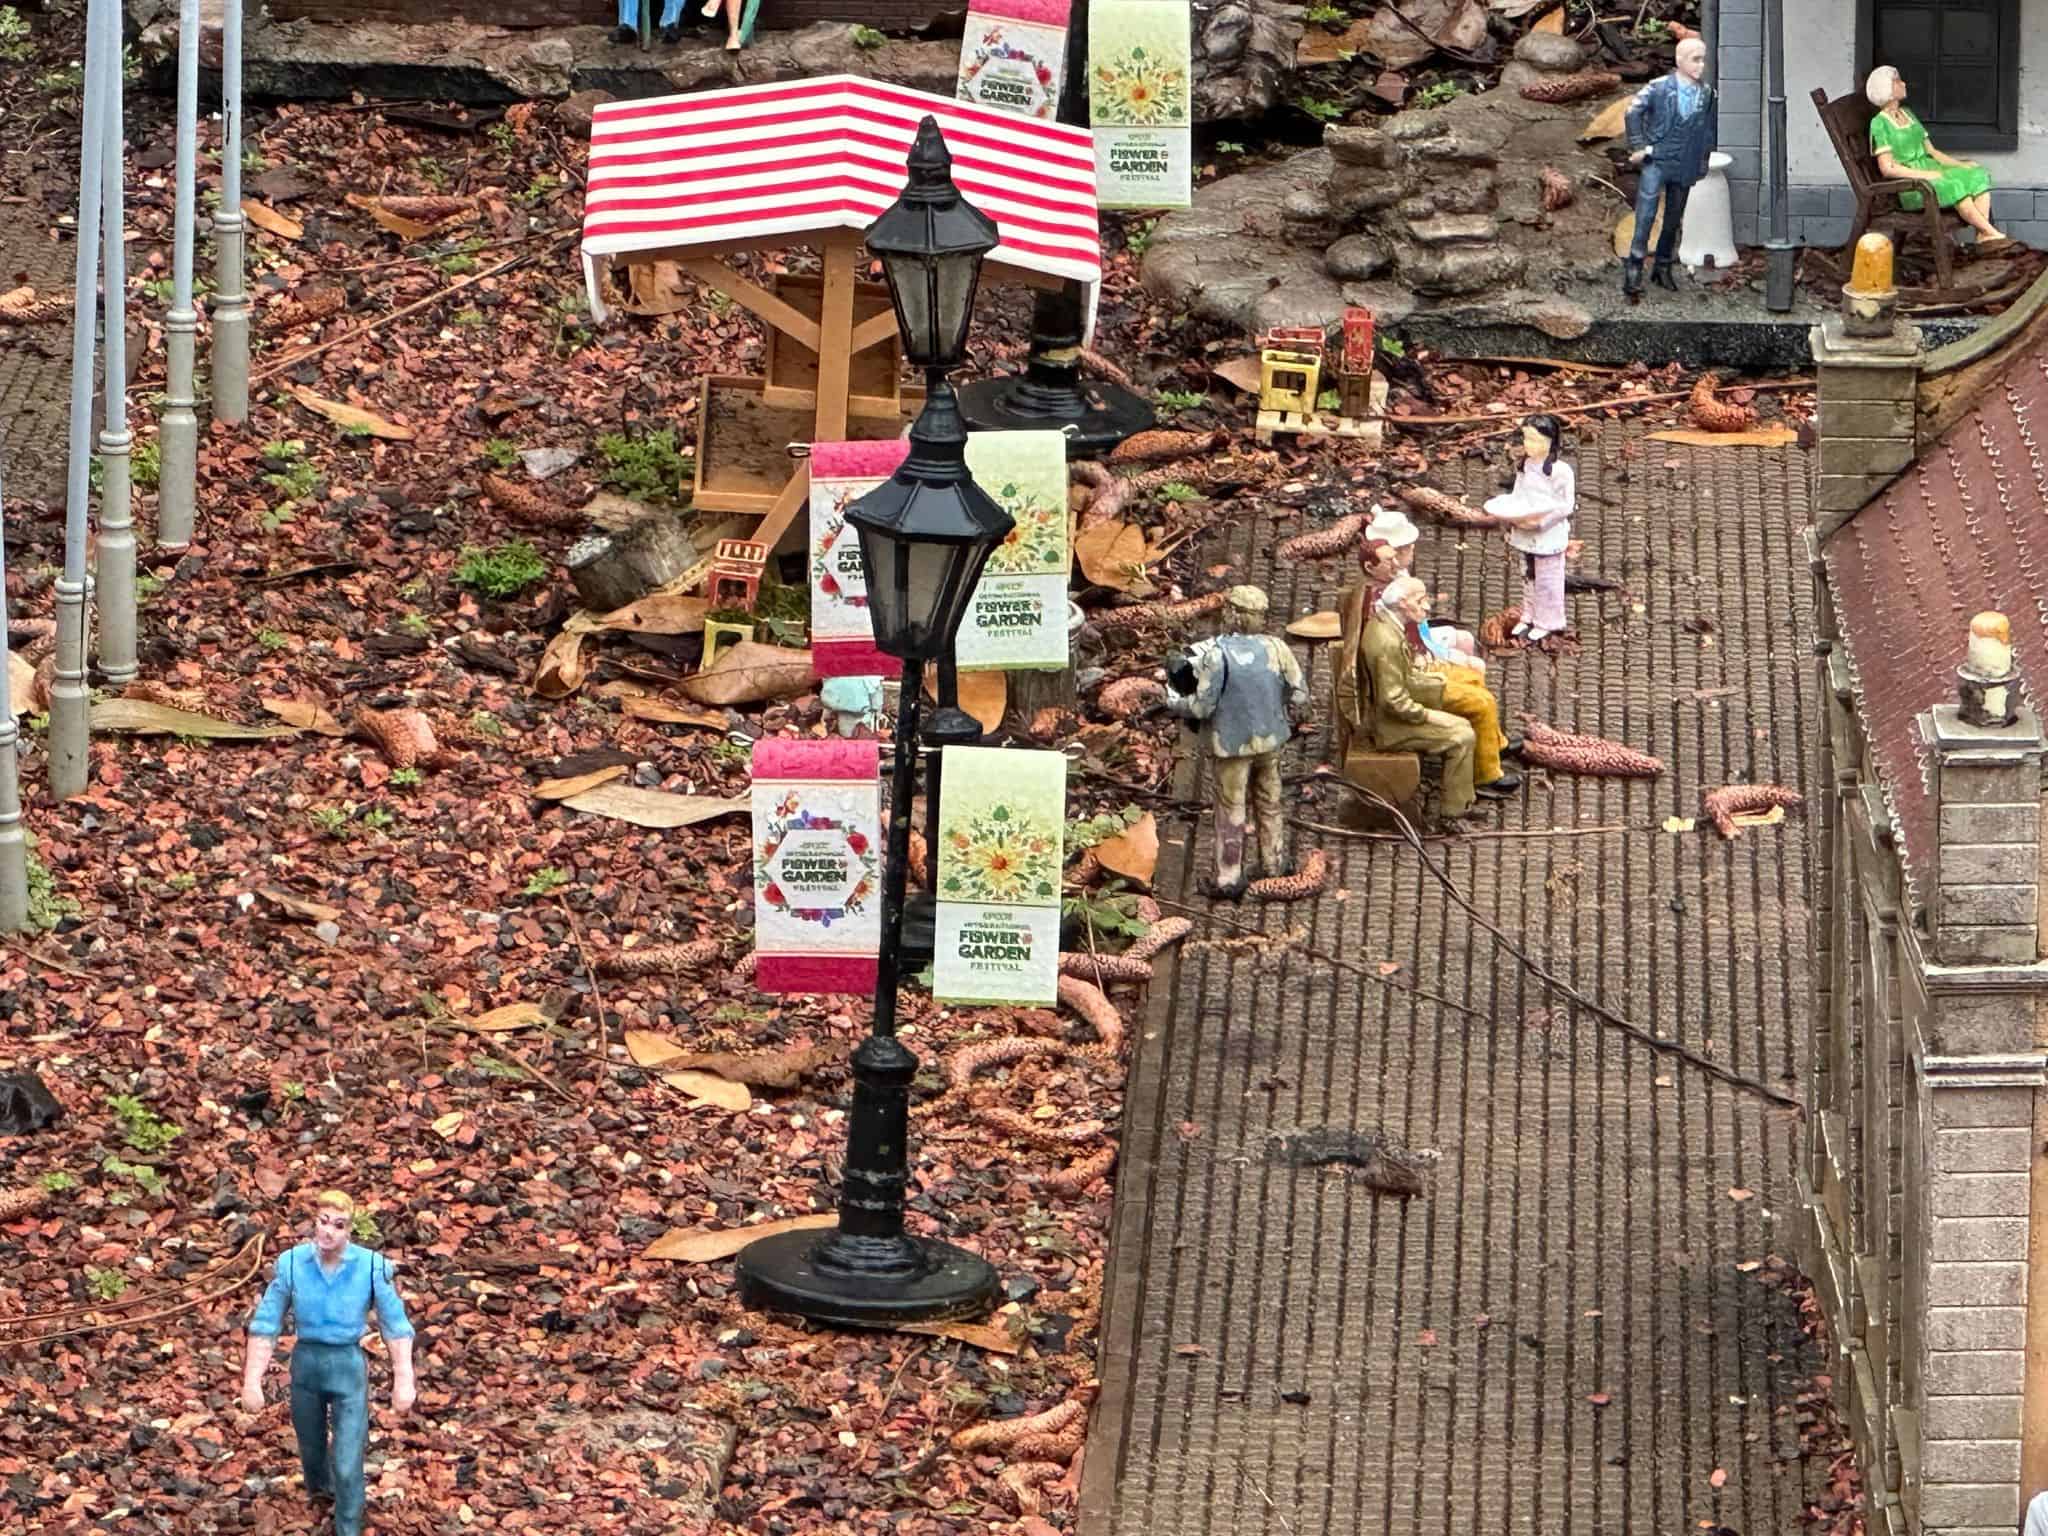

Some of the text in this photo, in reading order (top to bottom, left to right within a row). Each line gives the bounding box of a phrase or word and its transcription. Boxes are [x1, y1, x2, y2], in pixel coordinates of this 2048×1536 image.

[980, 89, 1032, 105] GARDEN
[1110, 149, 1158, 160] FLOWER
[1110, 161, 1168, 173] GARDEN
[976, 613, 1042, 627] GARDEN
[782, 859, 836, 870] FLOWER
[782, 870, 847, 882] GARDEN
[960, 930, 1020, 944] FLOWER
[959, 944, 1031, 960] GARDEN
